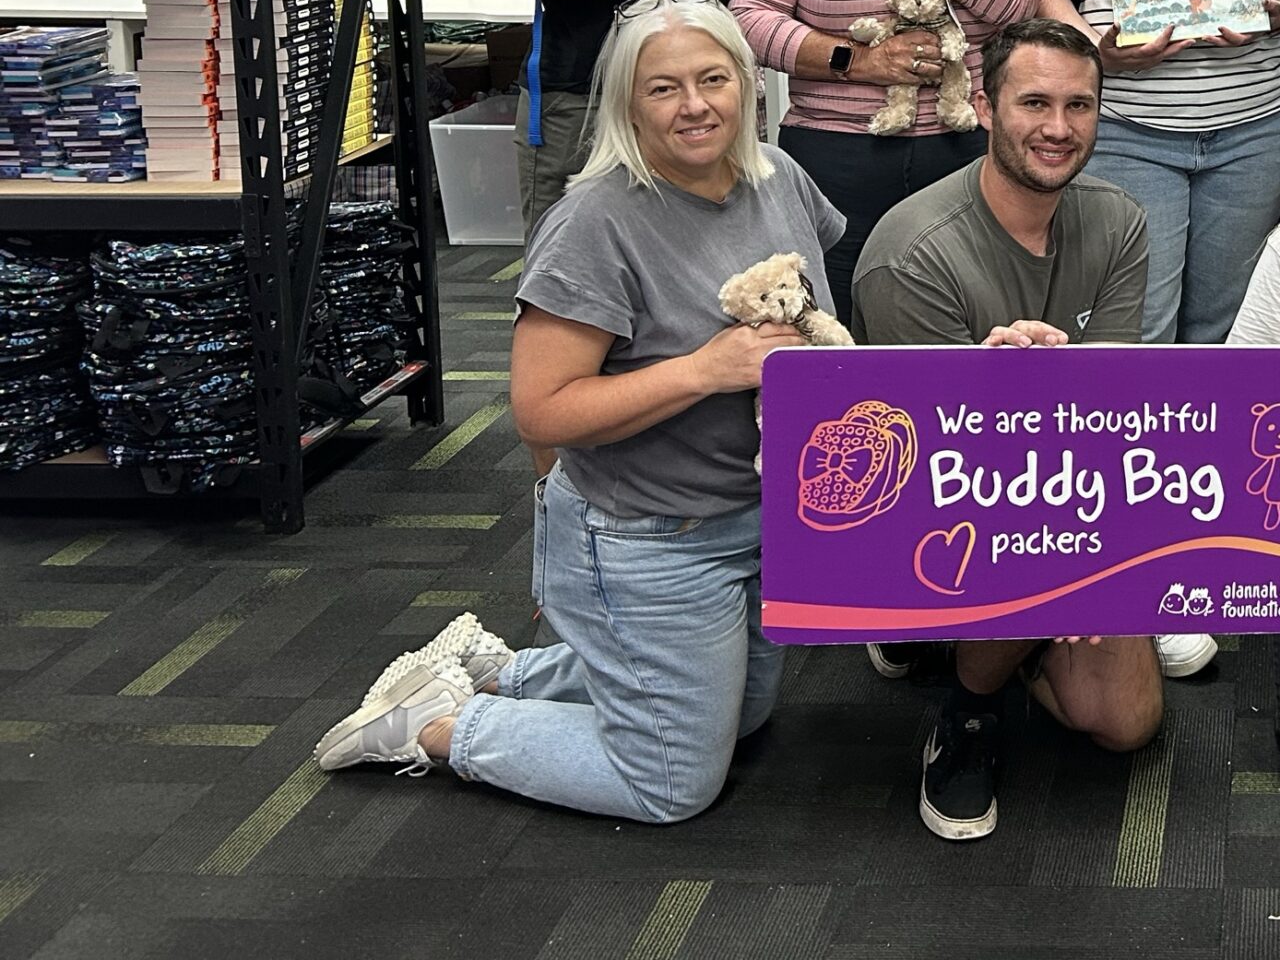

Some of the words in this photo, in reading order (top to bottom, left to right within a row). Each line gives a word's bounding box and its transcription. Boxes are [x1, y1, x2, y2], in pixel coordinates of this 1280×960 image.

[936, 404, 983, 435] We
[995, 410, 1042, 435] are
[1053, 402, 1218, 442] thoughtful
[929, 449, 1106, 524] Buddy
[1122, 447, 1226, 522] Bag
[991, 523, 1103, 564] packers
[1223, 581, 1278, 599] alannah
